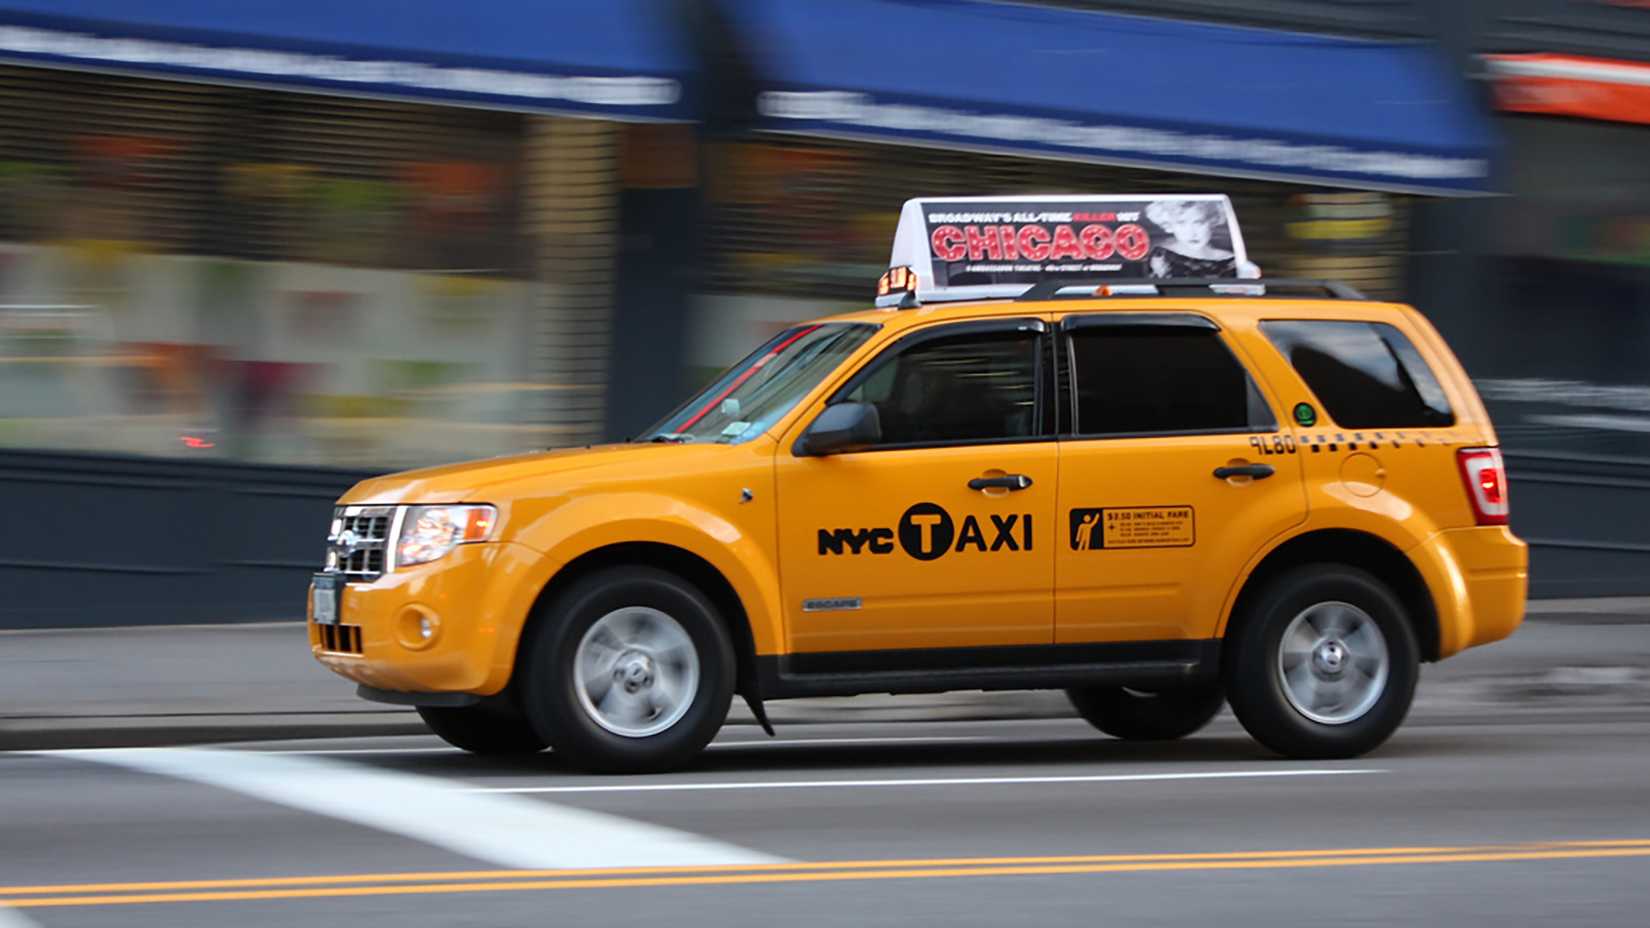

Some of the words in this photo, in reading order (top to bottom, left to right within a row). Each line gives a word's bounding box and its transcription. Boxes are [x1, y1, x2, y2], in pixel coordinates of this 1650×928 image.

[931, 223, 1149, 262] CHICAGO
[1249, 434, 1297, 455] 9L80
[1133, 511, 1165, 520] INITIAL
[1167, 510, 1189, 519] FARE
[817, 528, 894, 555] NYC
